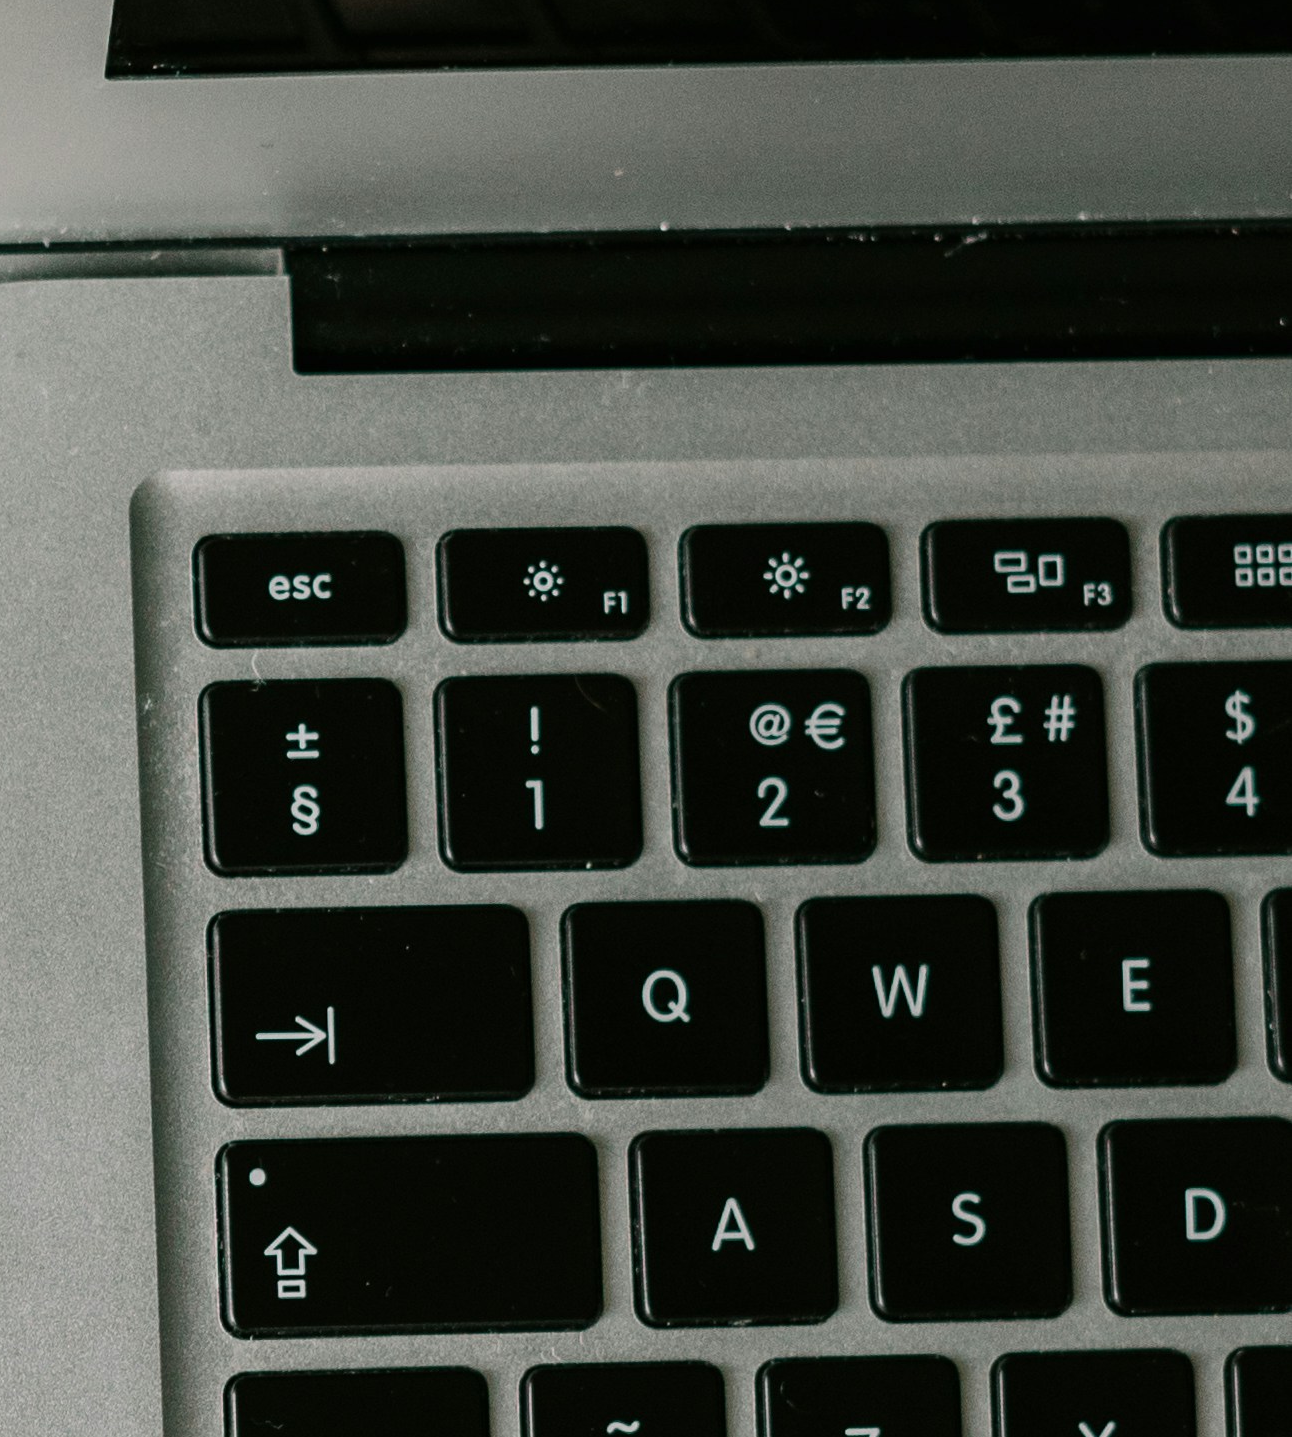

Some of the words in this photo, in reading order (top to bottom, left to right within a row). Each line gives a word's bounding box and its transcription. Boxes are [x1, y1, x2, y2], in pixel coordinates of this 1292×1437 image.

[268, 573, 332, 601] esc
[603, 590, 628, 615] F1
[841, 586, 871, 610] F2
[1082, 582, 1113, 607] F3
[749, 703, 792, 746] @
[804, 702, 846, 750] €
[986, 696, 1024, 745] £
[1042, 694, 1076, 742] #
[1224, 689, 1256, 745] $
[525, 779, 545, 831] 1
[757, 776, 790, 827] 2
[992, 769, 1025, 822] 3
[1225, 766, 1260, 817] 4
[641, 969, 691, 1023] Q
[871, 963, 929, 1019] W
[1121, 958, 1152, 1012] E
[711, 1197, 756, 1252] A
[951, 1192, 986, 1246] S
[1184, 1187, 1227, 1241] D
